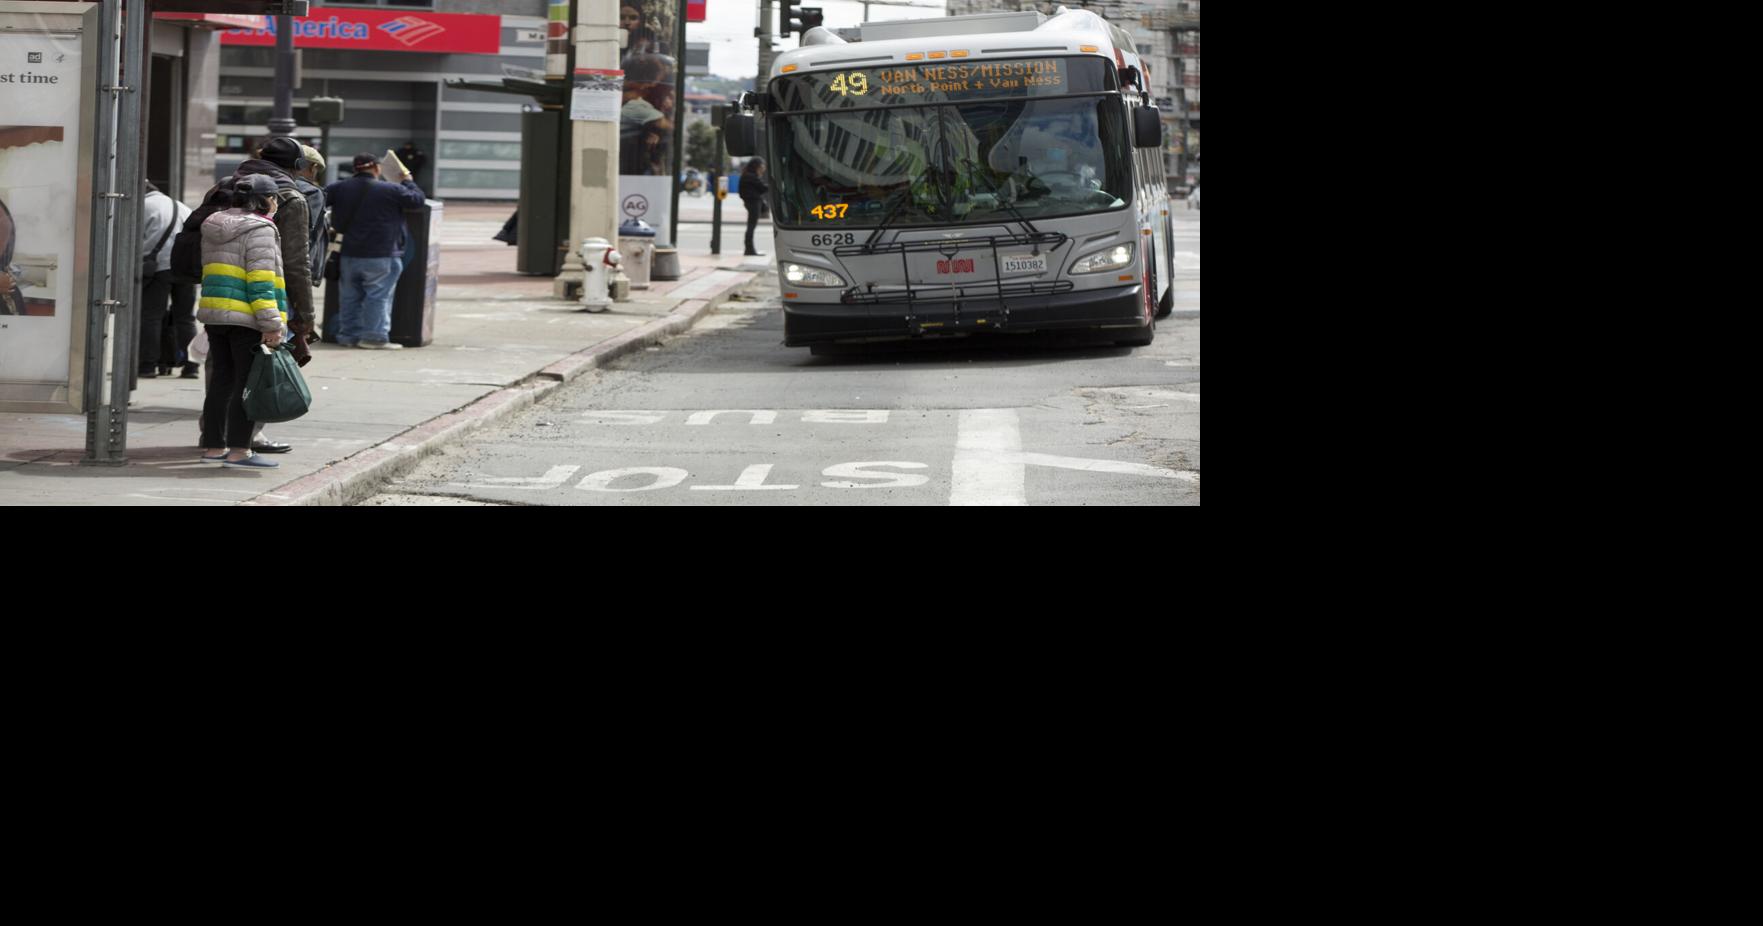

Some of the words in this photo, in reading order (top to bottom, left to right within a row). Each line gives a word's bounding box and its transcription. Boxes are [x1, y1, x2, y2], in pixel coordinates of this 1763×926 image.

[257, 15, 369, 39] Aerica
[20, 71, 58, 84] time
[881, 68, 916, 83] VAN
[830, 72, 868, 96] 49
[881, 82, 925, 95] North
[930, 80, 968, 92] Point
[989, 78, 1019, 88] Van
[1023, 75, 1061, 87] Ness
[811, 203, 848, 218] 437
[811, 232, 855, 246] 6628
[1005, 260, 1043, 271] 1510382
